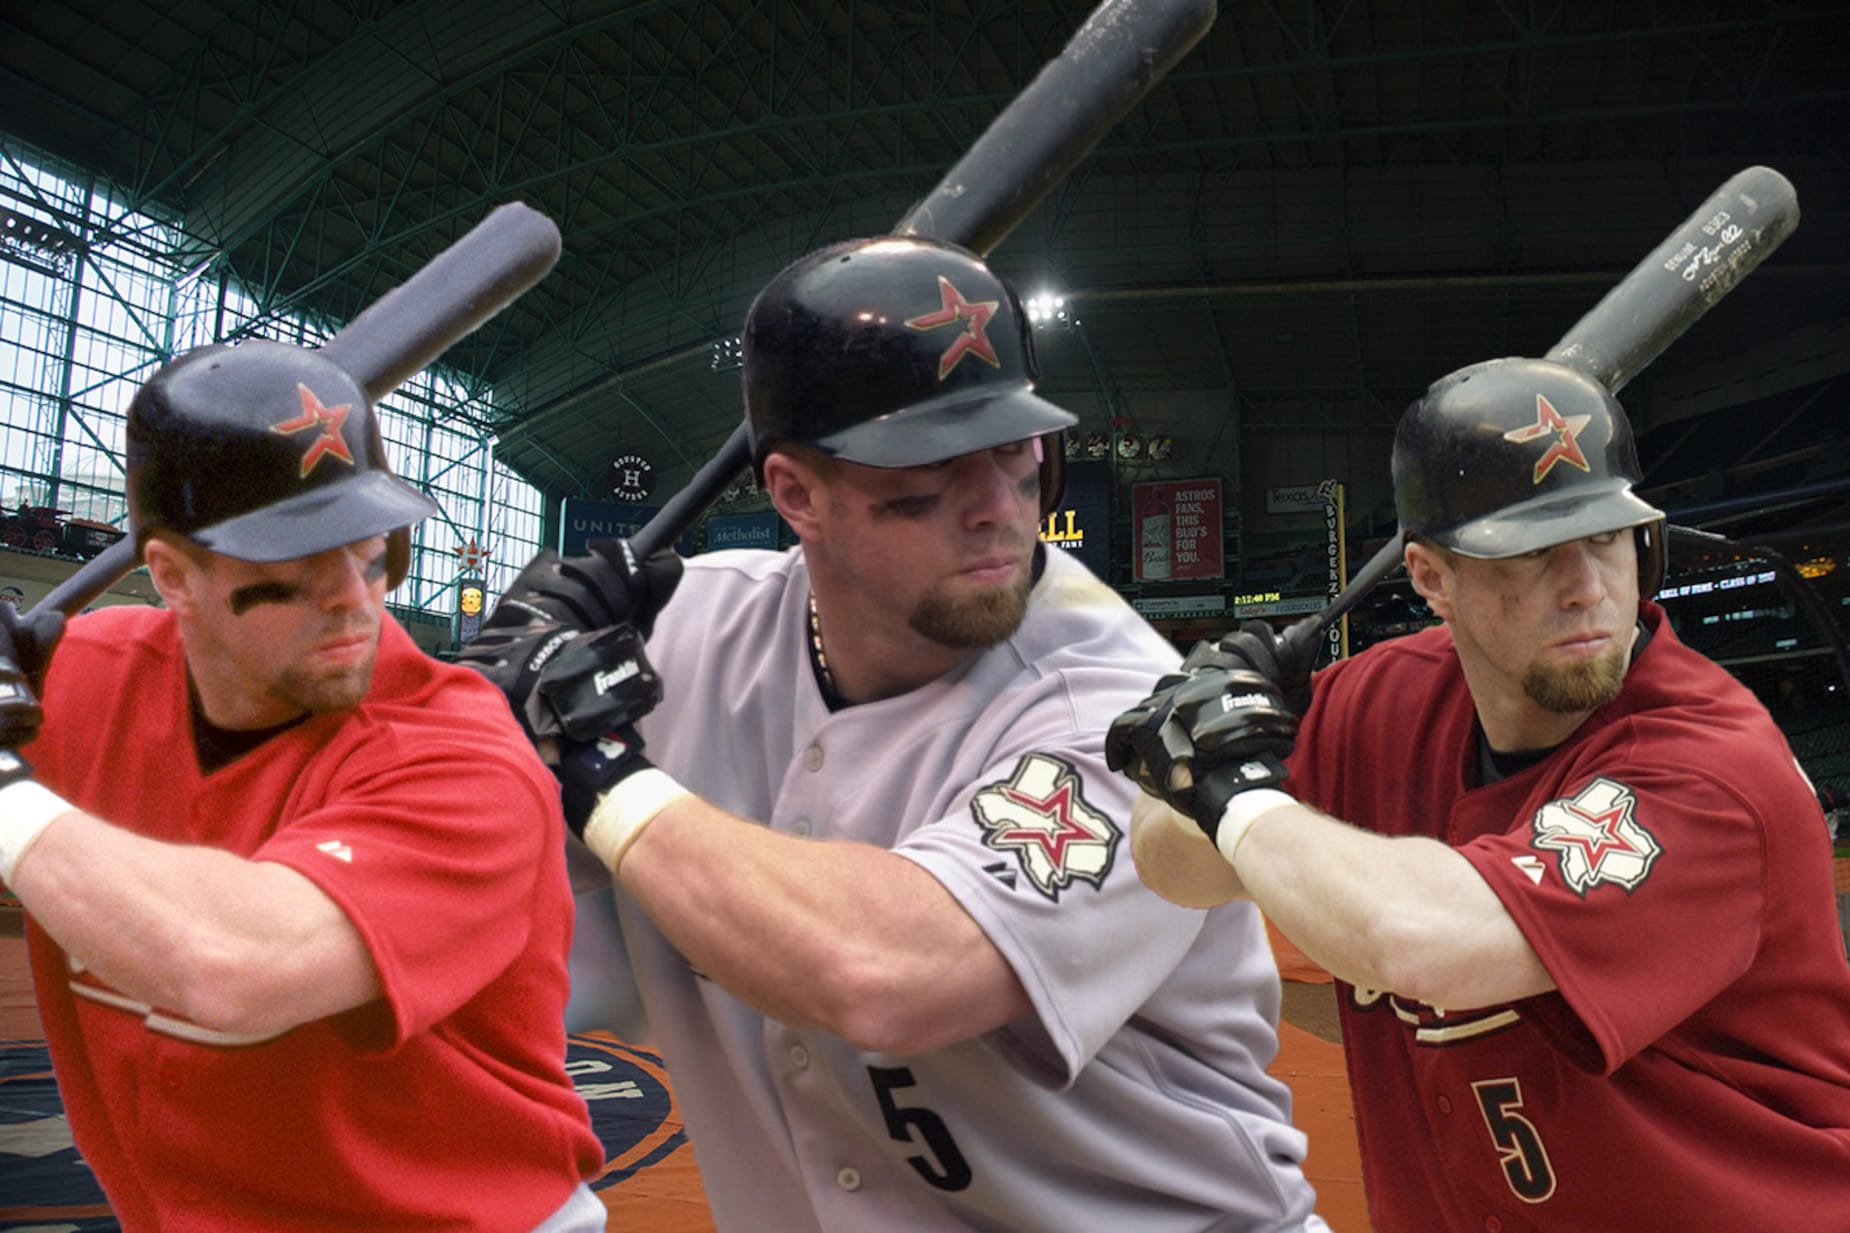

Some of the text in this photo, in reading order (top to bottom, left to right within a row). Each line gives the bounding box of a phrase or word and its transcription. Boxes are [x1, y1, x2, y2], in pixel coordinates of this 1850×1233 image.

[622, 469, 641, 488] H
[1175, 489, 1216, 502] ASTROS
[573, 519, 642, 536] UNITE
[1175, 515, 1200, 526] THIS
[713, 525, 771, 543] Methodist
[1175, 526, 1208, 539] BUD'S
[1175, 539, 1197, 551] FOR
[866, 1064, 973, 1193] 5
[1471, 1077, 1557, 1204] 5
